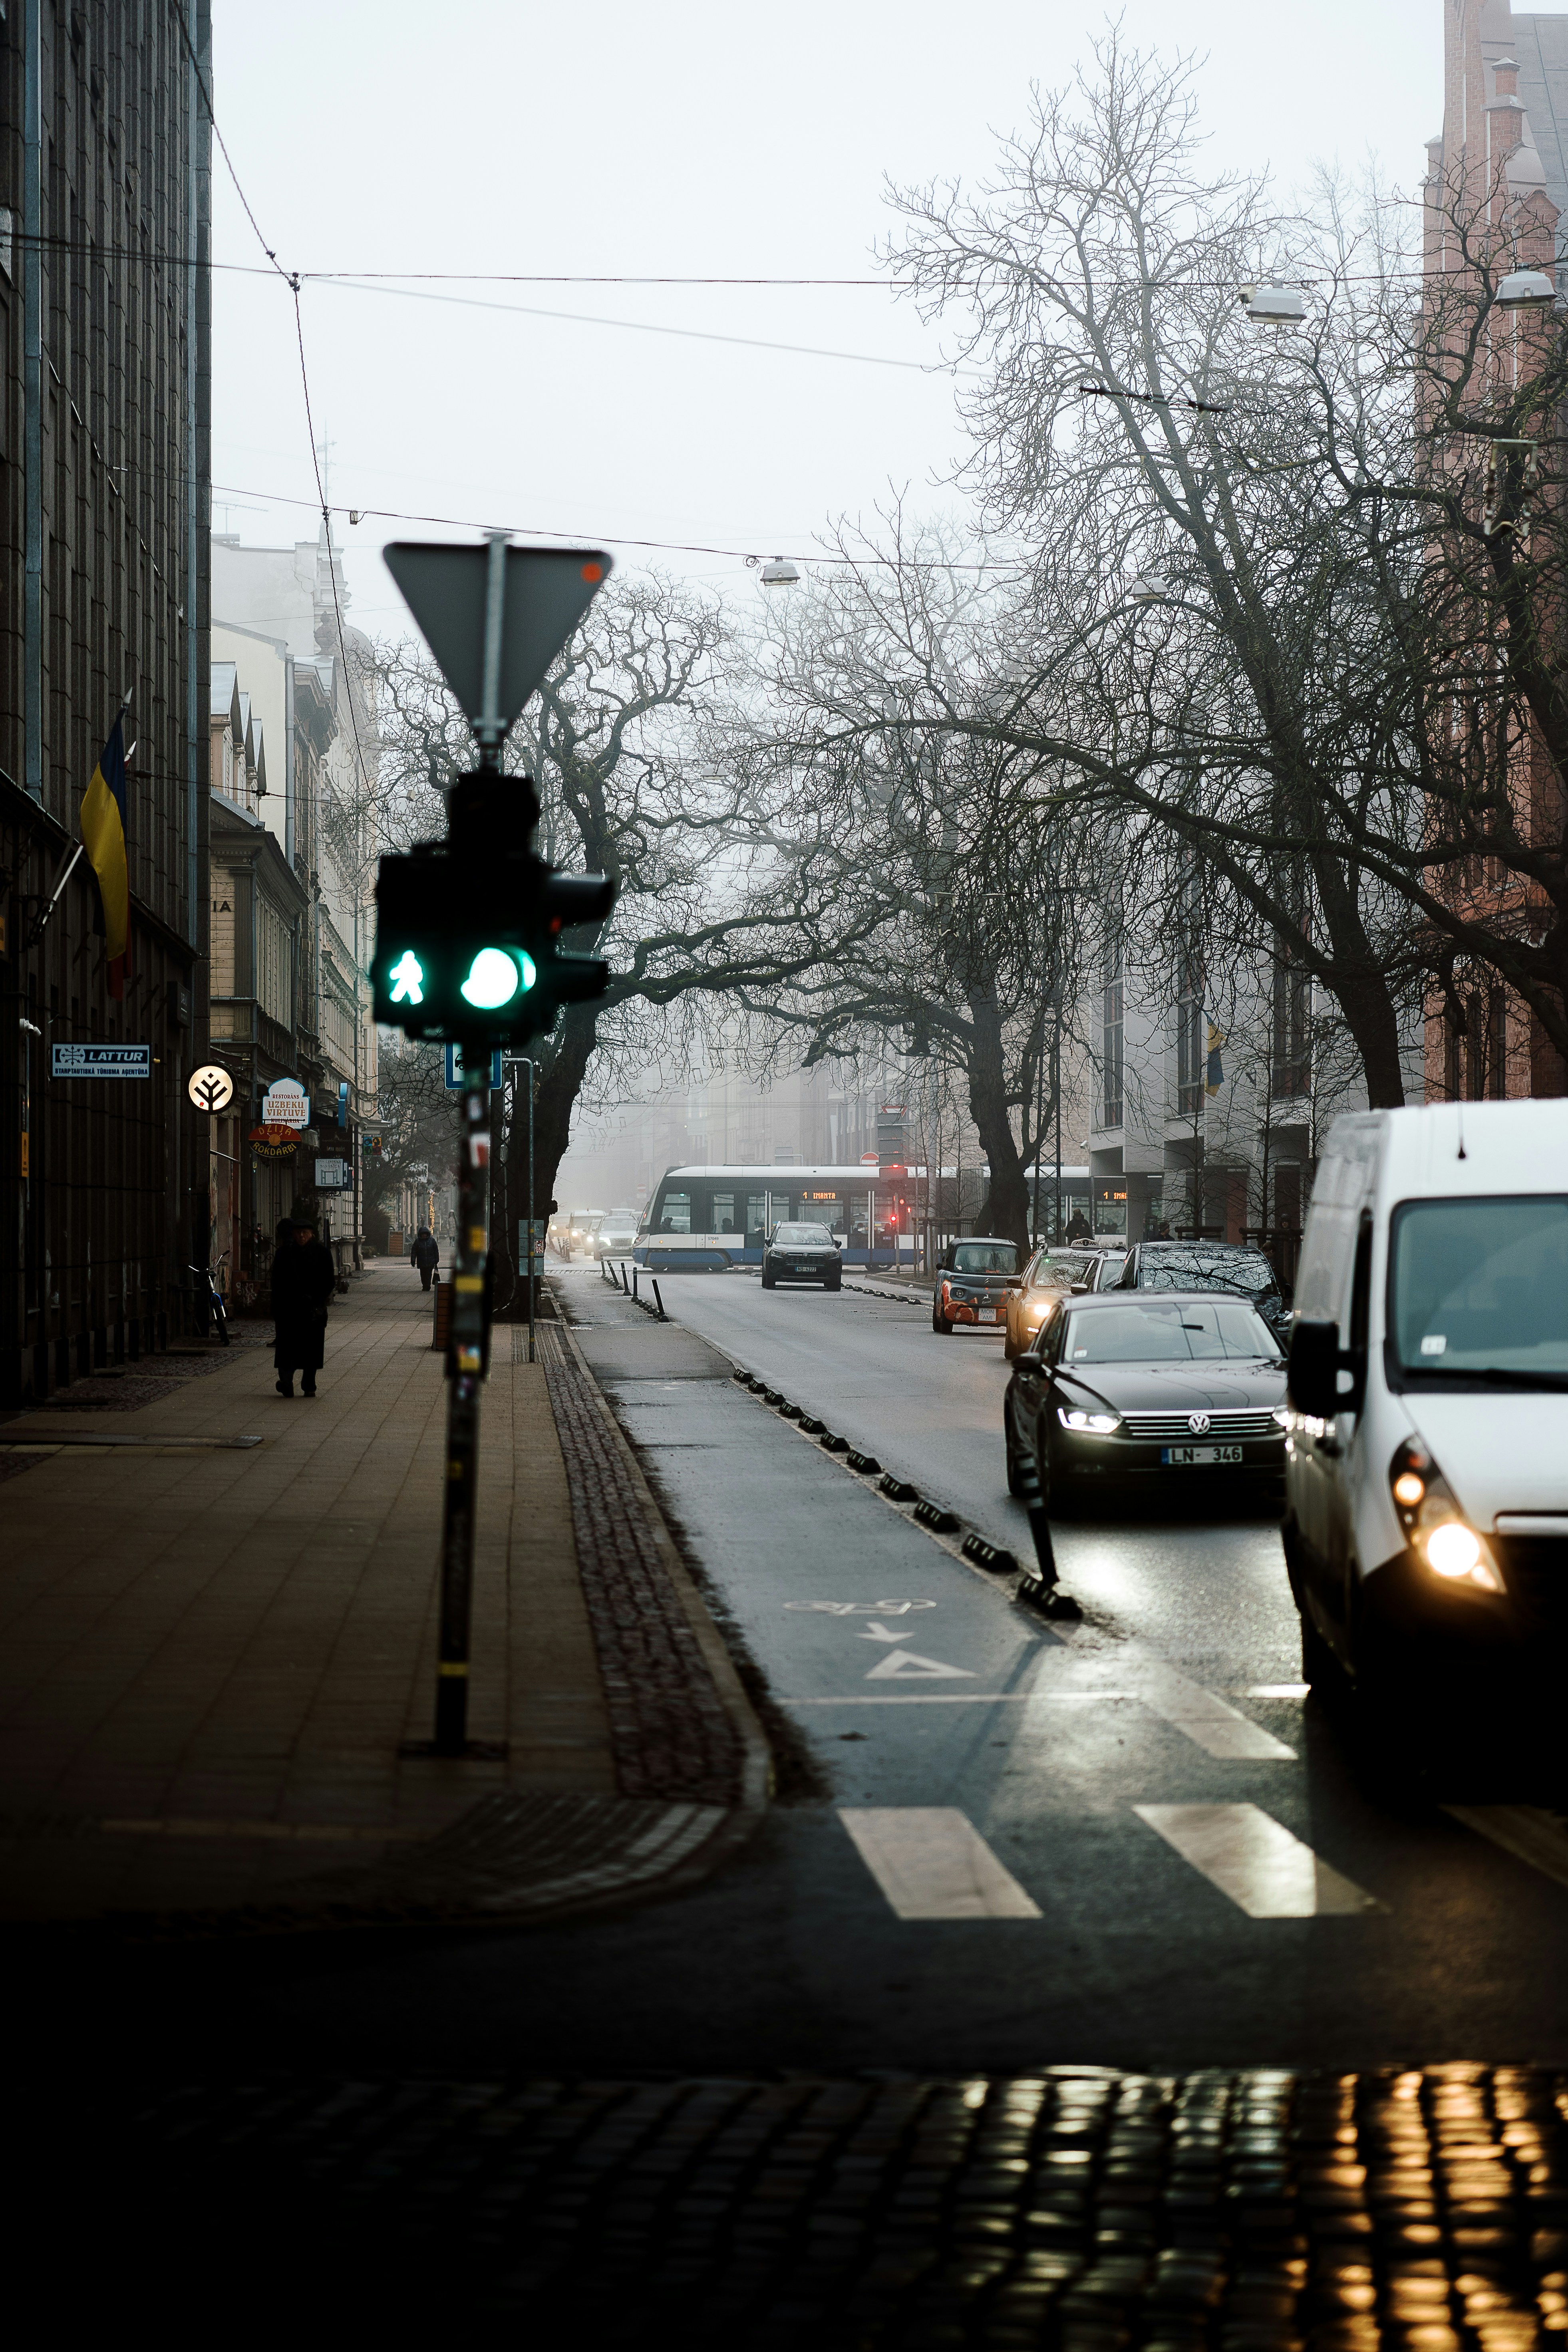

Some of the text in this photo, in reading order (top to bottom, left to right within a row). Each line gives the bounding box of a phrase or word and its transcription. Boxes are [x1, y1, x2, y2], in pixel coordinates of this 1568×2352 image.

[89, 1052, 143, 1061] LATTUR
[121, 1068, 148, 1076] AĢENTŪRA
[258, 1125, 291, 1136] DZIJA
[252, 1142, 297, 1155] ROKDARBI
[1213, 1447, 1241, 1461] 346
